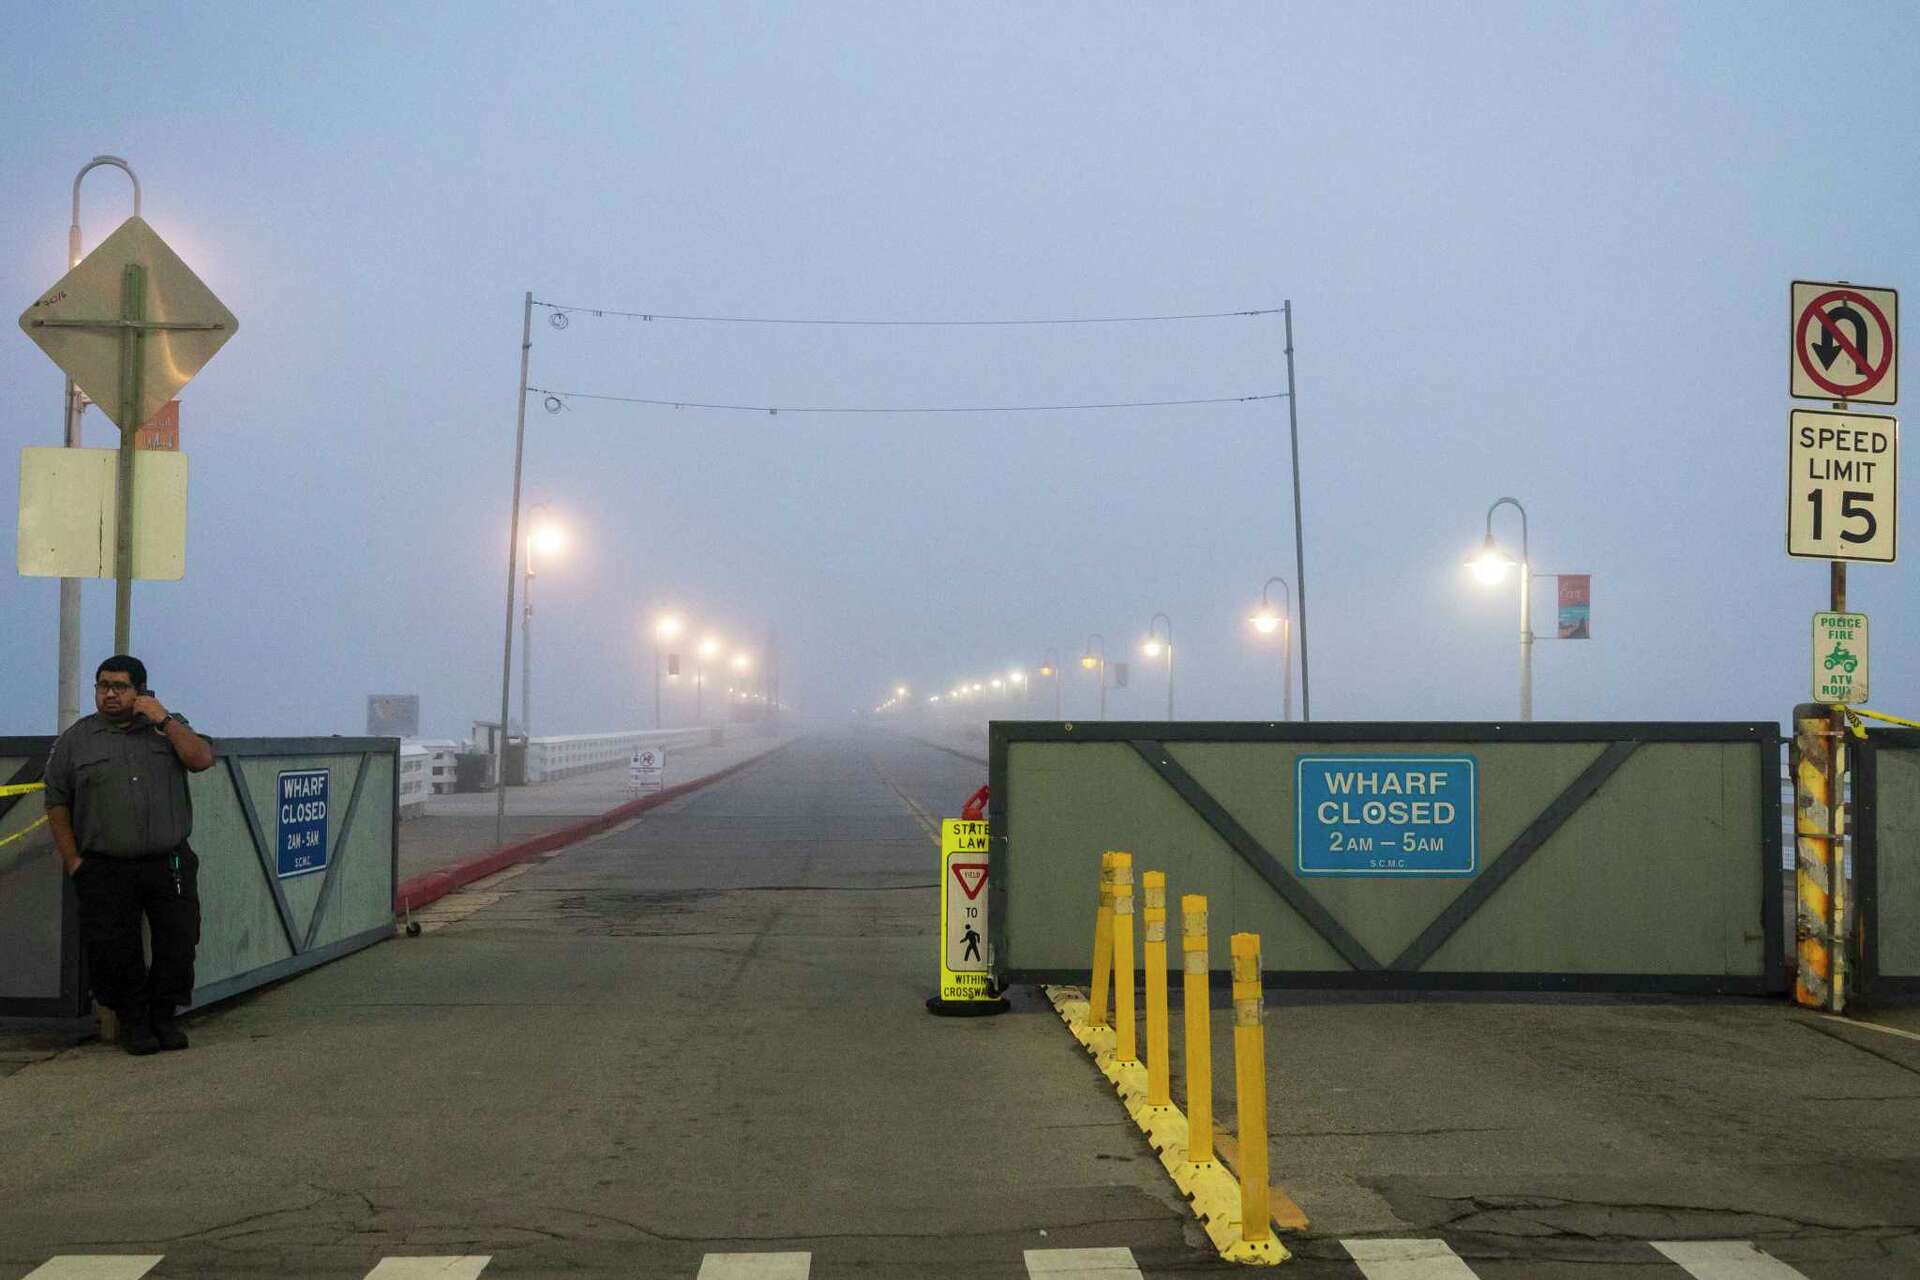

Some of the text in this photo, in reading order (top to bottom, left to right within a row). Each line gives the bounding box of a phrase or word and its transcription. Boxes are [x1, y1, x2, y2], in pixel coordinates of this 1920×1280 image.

[1800, 427, 1888, 454] SPEED
[1809, 458, 1876, 483] LIMIT
[1807, 488, 1877, 544] 15
[1821, 617, 1862, 628] POLICE
[1828, 630, 1854, 640] FIRE
[1830, 675, 1852, 684] ATV
[284, 776, 325, 799] WHARF
[1324, 772, 1448, 795] WHARF
[281, 801, 326, 824] CLOSED
[1317, 801, 1455, 825] CLOSED
[953, 823, 990, 835] STATE
[958, 837, 986, 848] LAW
[1329, 831, 1373, 851] 2AM
[1402, 832, 1444, 852] 5AM
[964, 871, 981, 879] YIELD
[966, 907, 978, 918] TO
[955, 975, 989, 984] WITHIN
